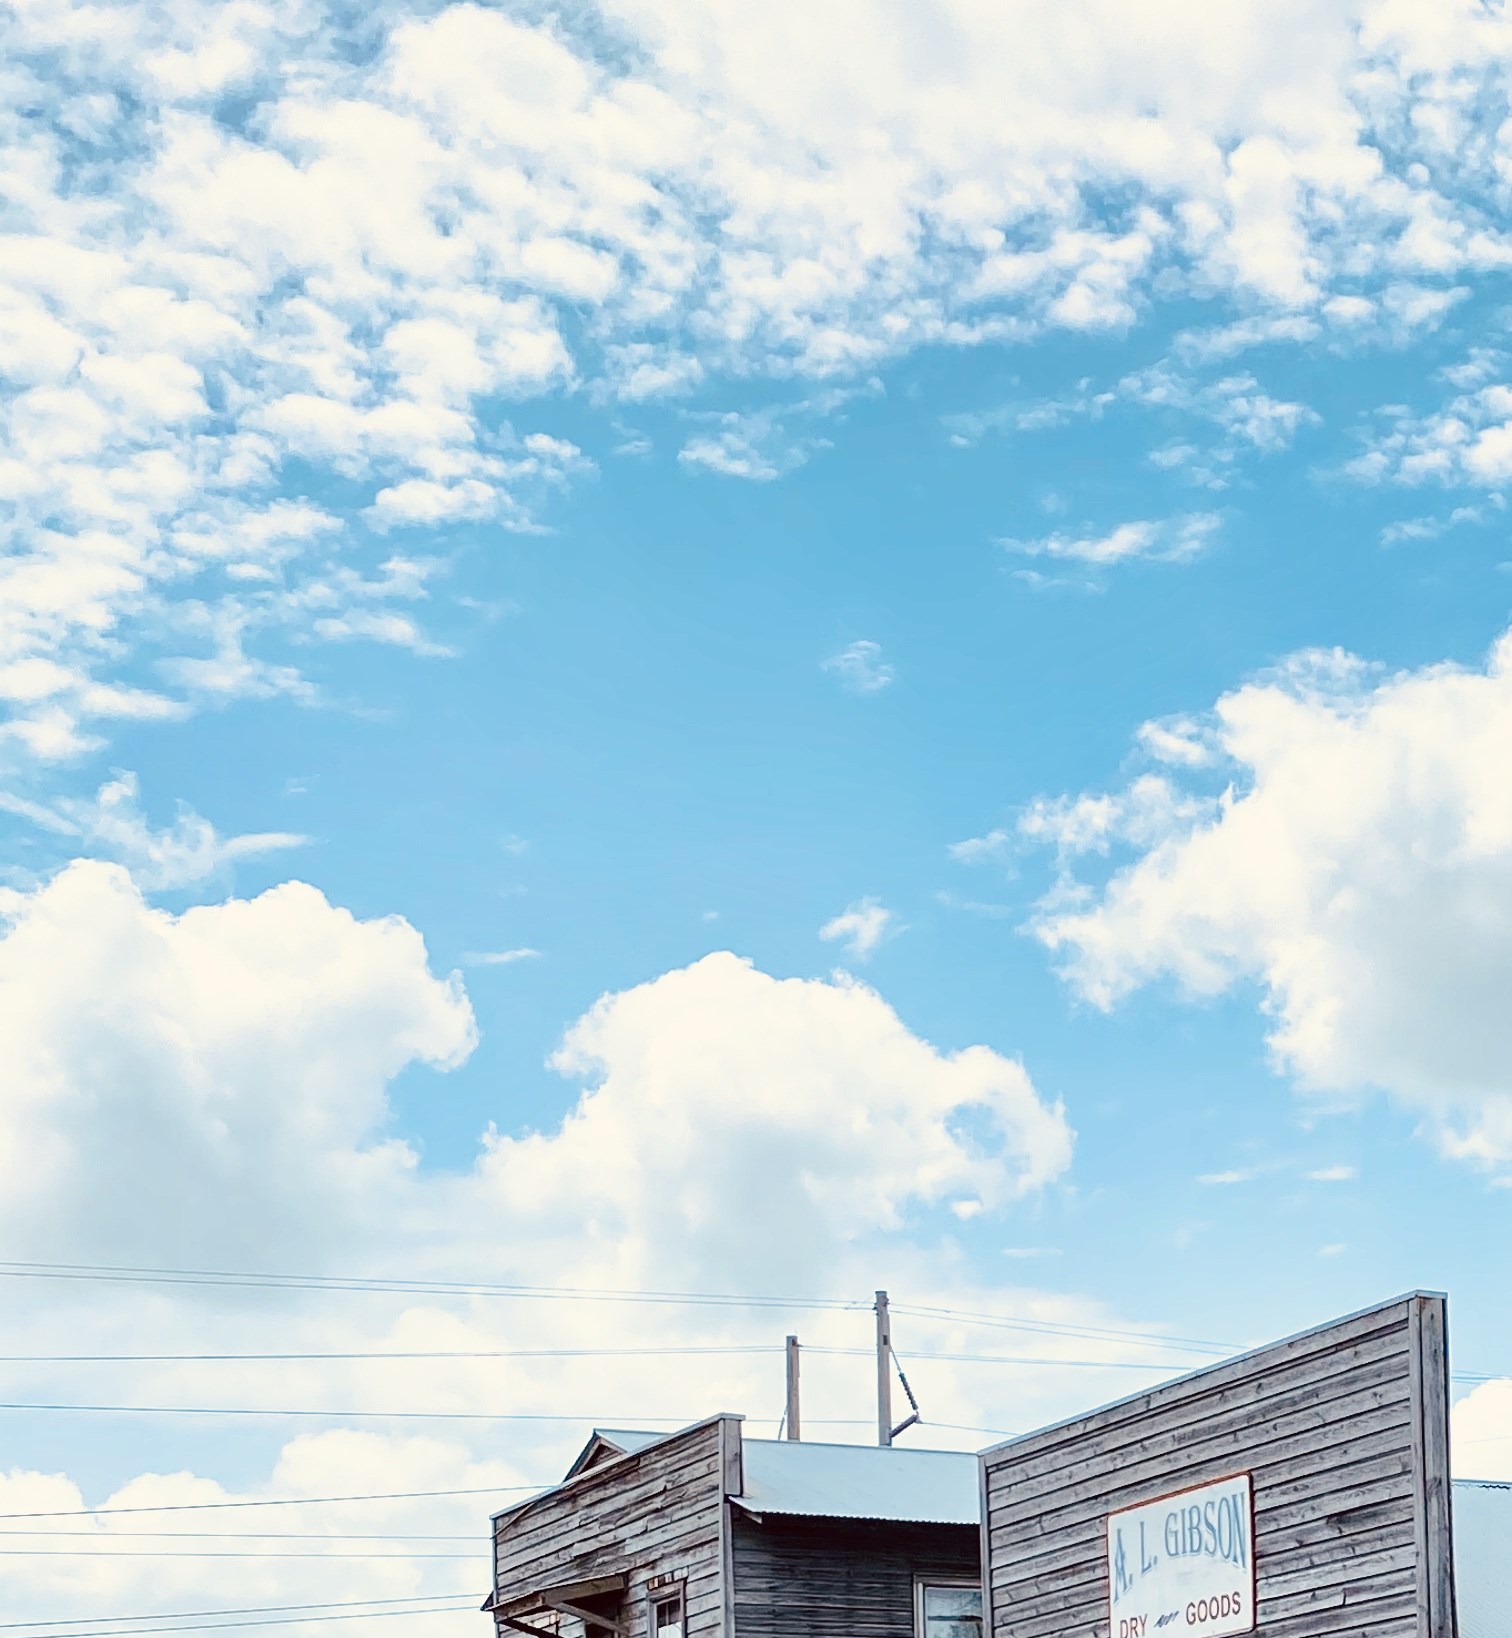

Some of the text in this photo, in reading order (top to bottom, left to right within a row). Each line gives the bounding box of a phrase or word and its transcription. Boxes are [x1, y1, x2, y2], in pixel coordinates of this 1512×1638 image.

[1140, 1520, 1158, 1575] L.
[1164, 1491, 1247, 1569] GIBSON
[1186, 1591, 1241, 1626] GOODS
